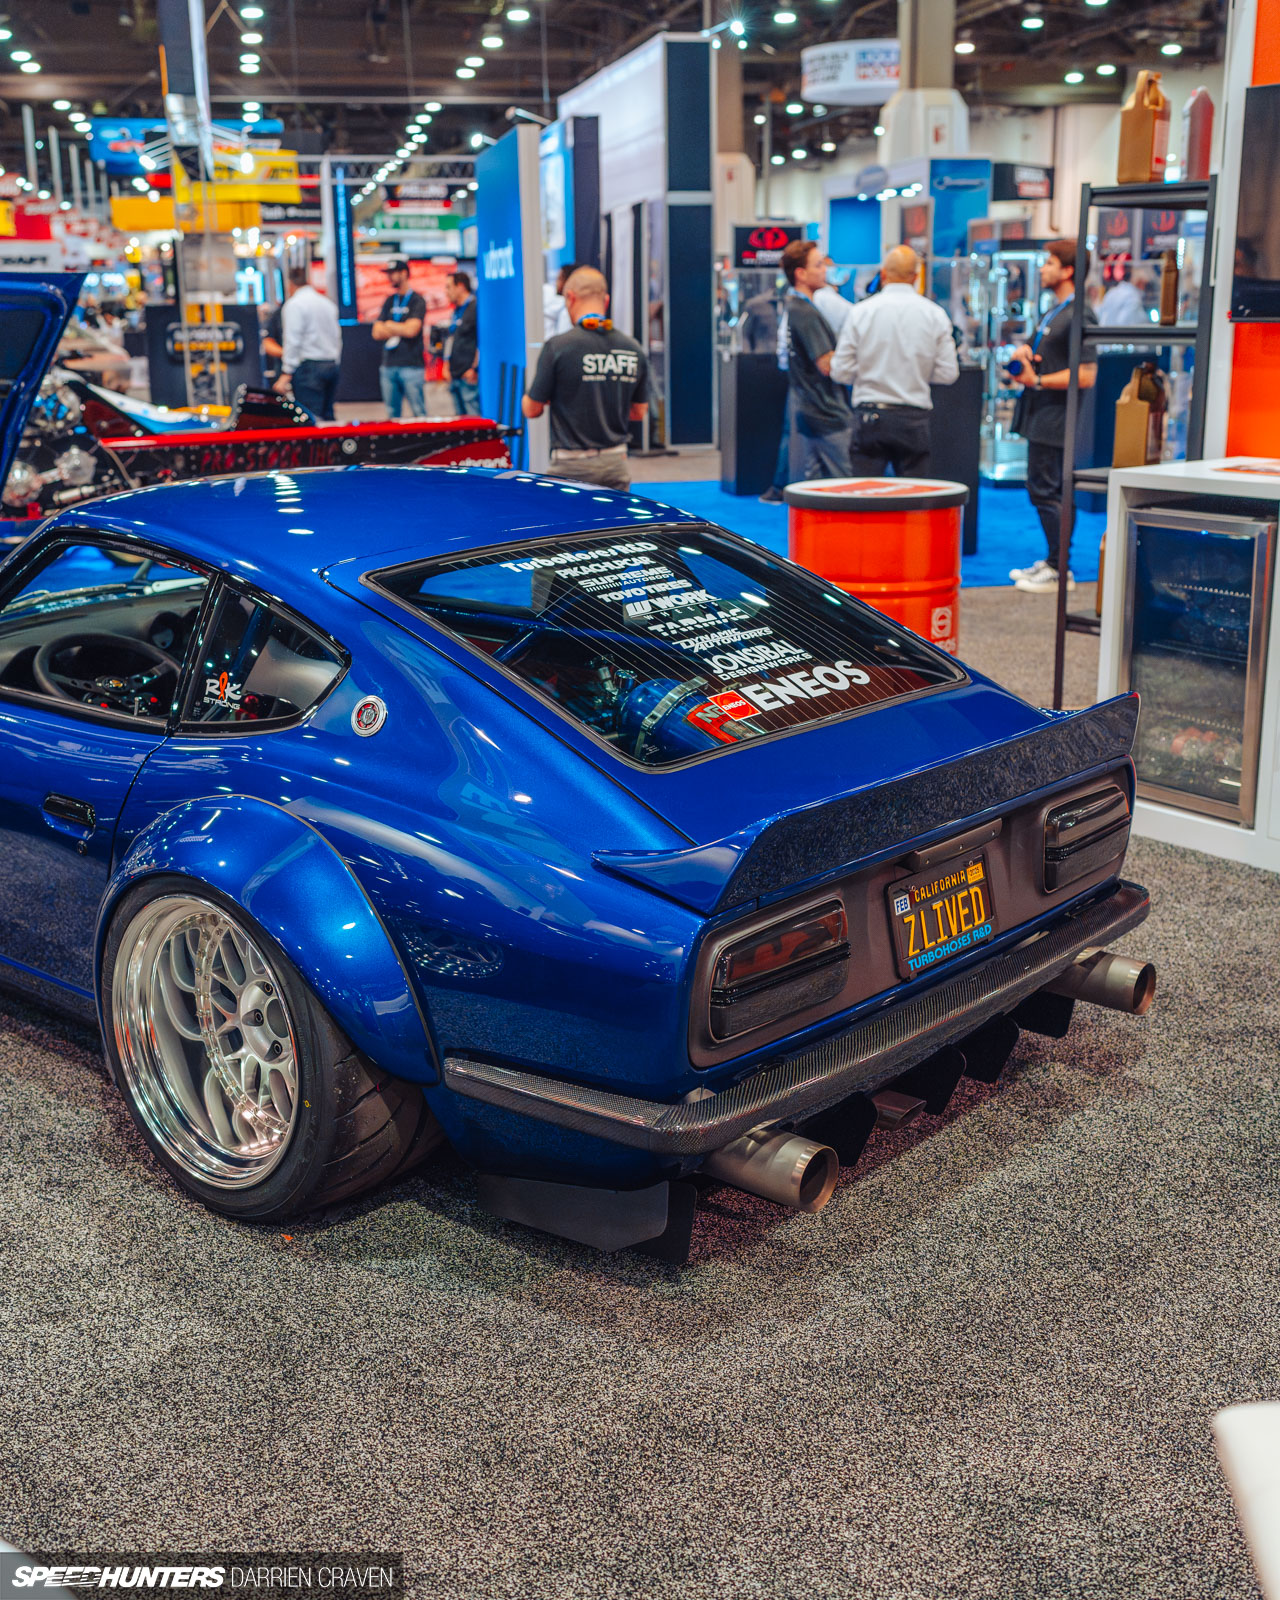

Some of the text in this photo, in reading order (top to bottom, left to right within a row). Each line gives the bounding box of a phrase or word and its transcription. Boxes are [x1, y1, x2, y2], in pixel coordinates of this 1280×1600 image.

[583, 354, 638, 375] STAFF
[578, 566, 672, 588] SUPREME
[623, 573, 675, 586] AUTOBODY
[597, 579, 693, 603] TOYO TIRES
[649, 589, 718, 611] WORK
[643, 601, 719, 620] WHEELS
[648, 608, 750, 637] TARMAC
[672, 627, 742, 650] DYNAMIC
[693, 627, 774, 653] AUTOWORKS
[703, 639, 805, 675] JONSIBAL
[718, 652, 814, 681] DESIGNWORKS
[740, 660, 871, 712] ENEOS
[203, 697, 240, 710] STRONG
[722, 700, 747, 711] ENEOS
[914, 870, 966, 903] CALIFORNIA
[895, 897, 909, 913] FEB
[908, 924, 992, 971] TURBOHOSES R&D
